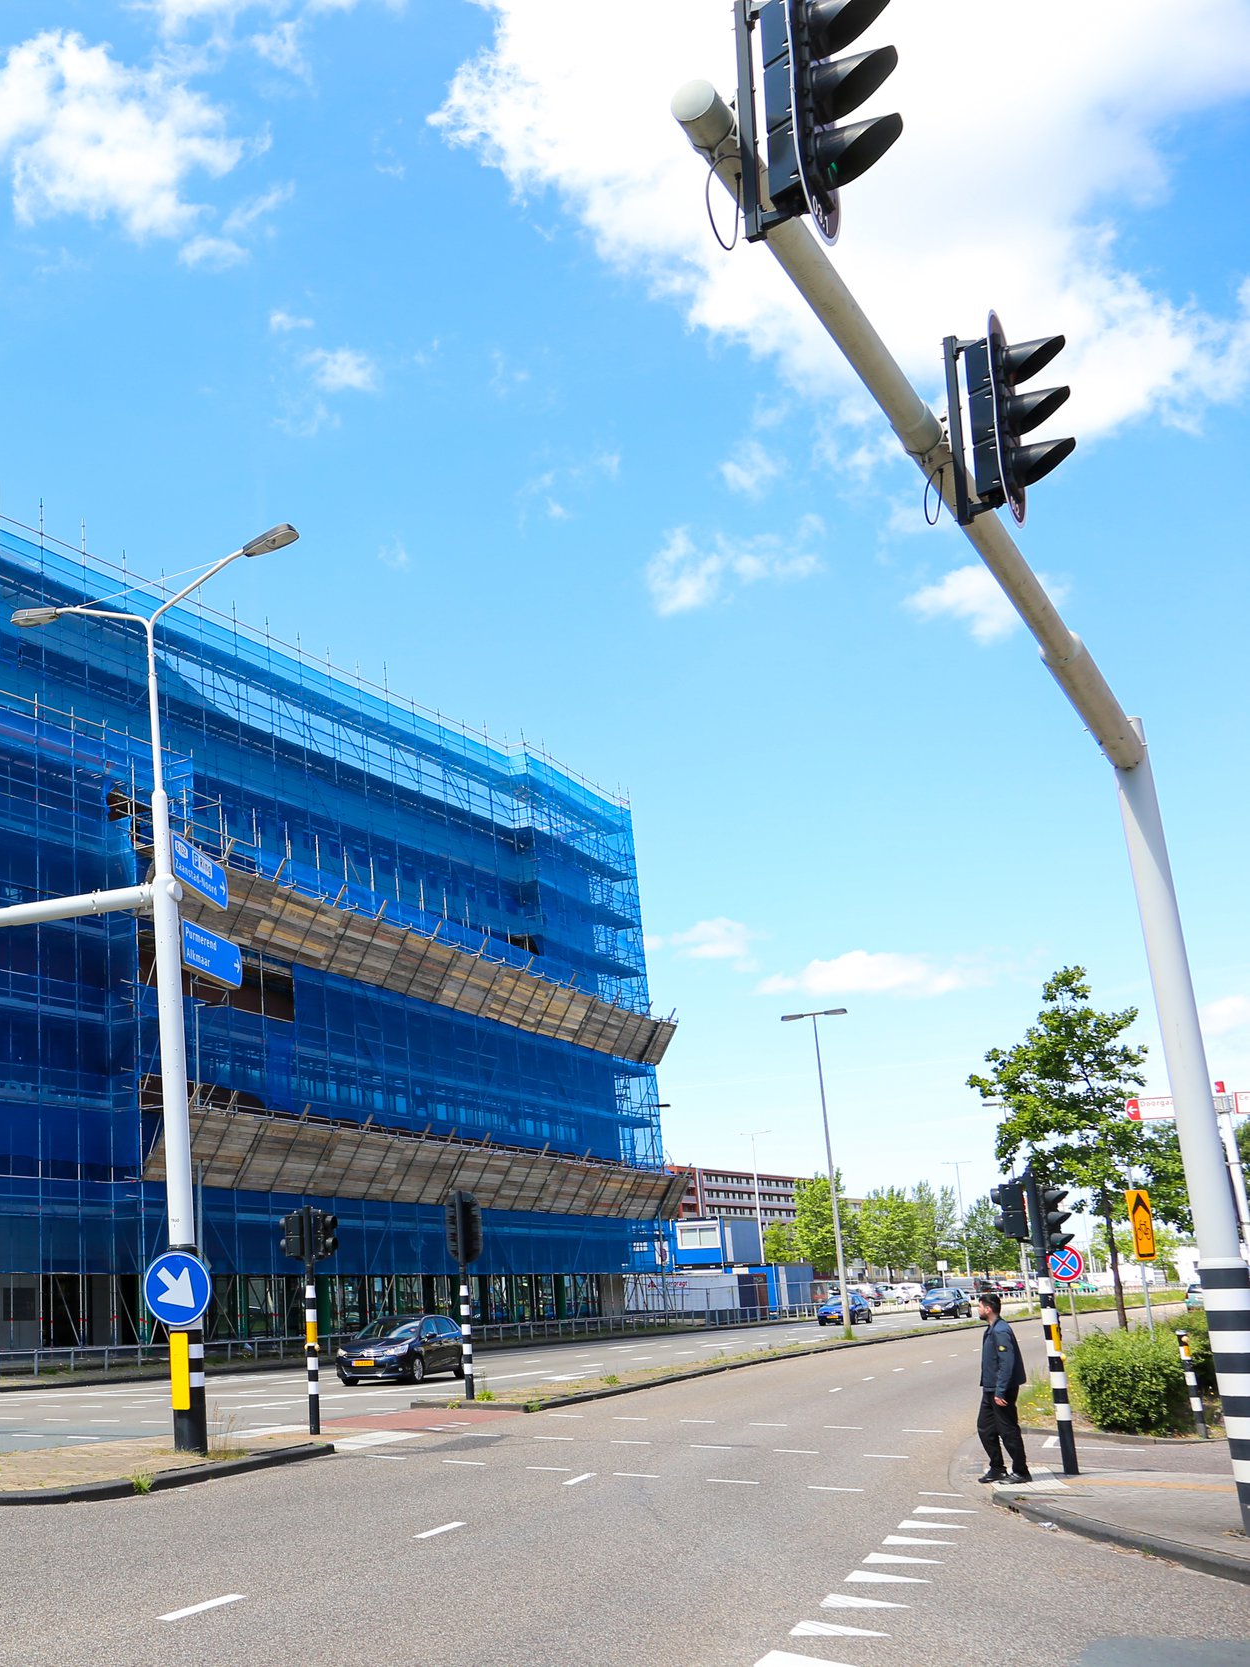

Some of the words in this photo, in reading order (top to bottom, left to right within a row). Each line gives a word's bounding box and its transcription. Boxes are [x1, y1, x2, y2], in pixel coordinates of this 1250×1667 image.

[174, 858, 217, 896] Zaanstad-Noord
[200, 856, 212, 877] Ring
[185, 926, 217, 952] Purmerend
[186, 947, 210, 968] Alkmaar
